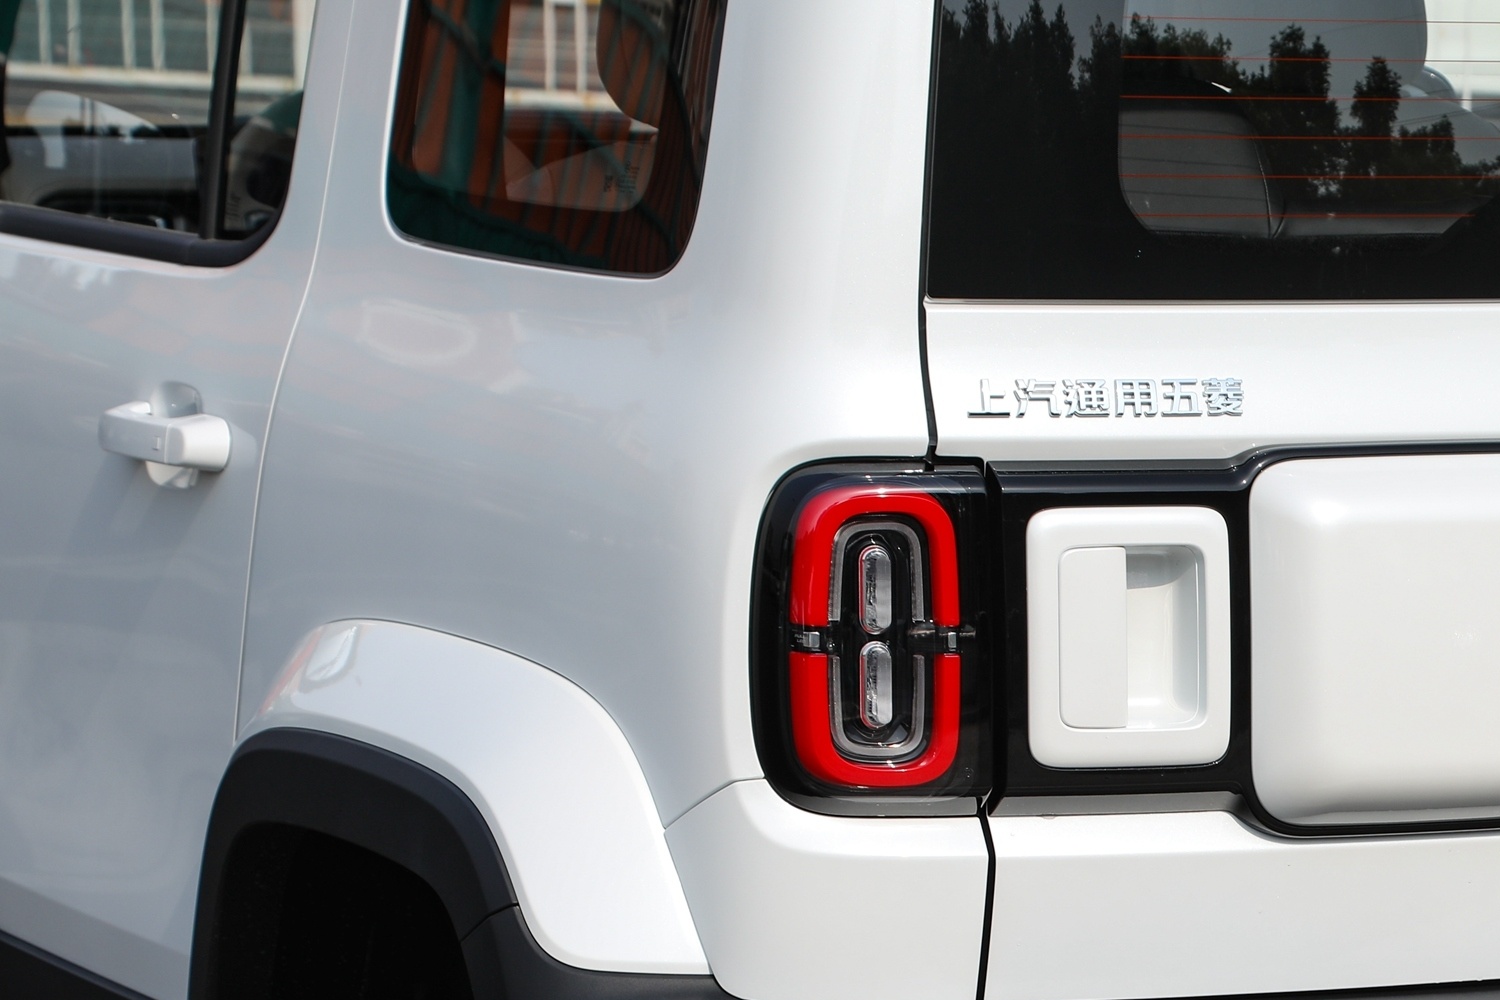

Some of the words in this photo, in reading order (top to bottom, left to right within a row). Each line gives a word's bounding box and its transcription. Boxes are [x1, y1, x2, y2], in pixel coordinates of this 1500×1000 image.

[967, 377, 1245, 418] 上汽通用五菱
